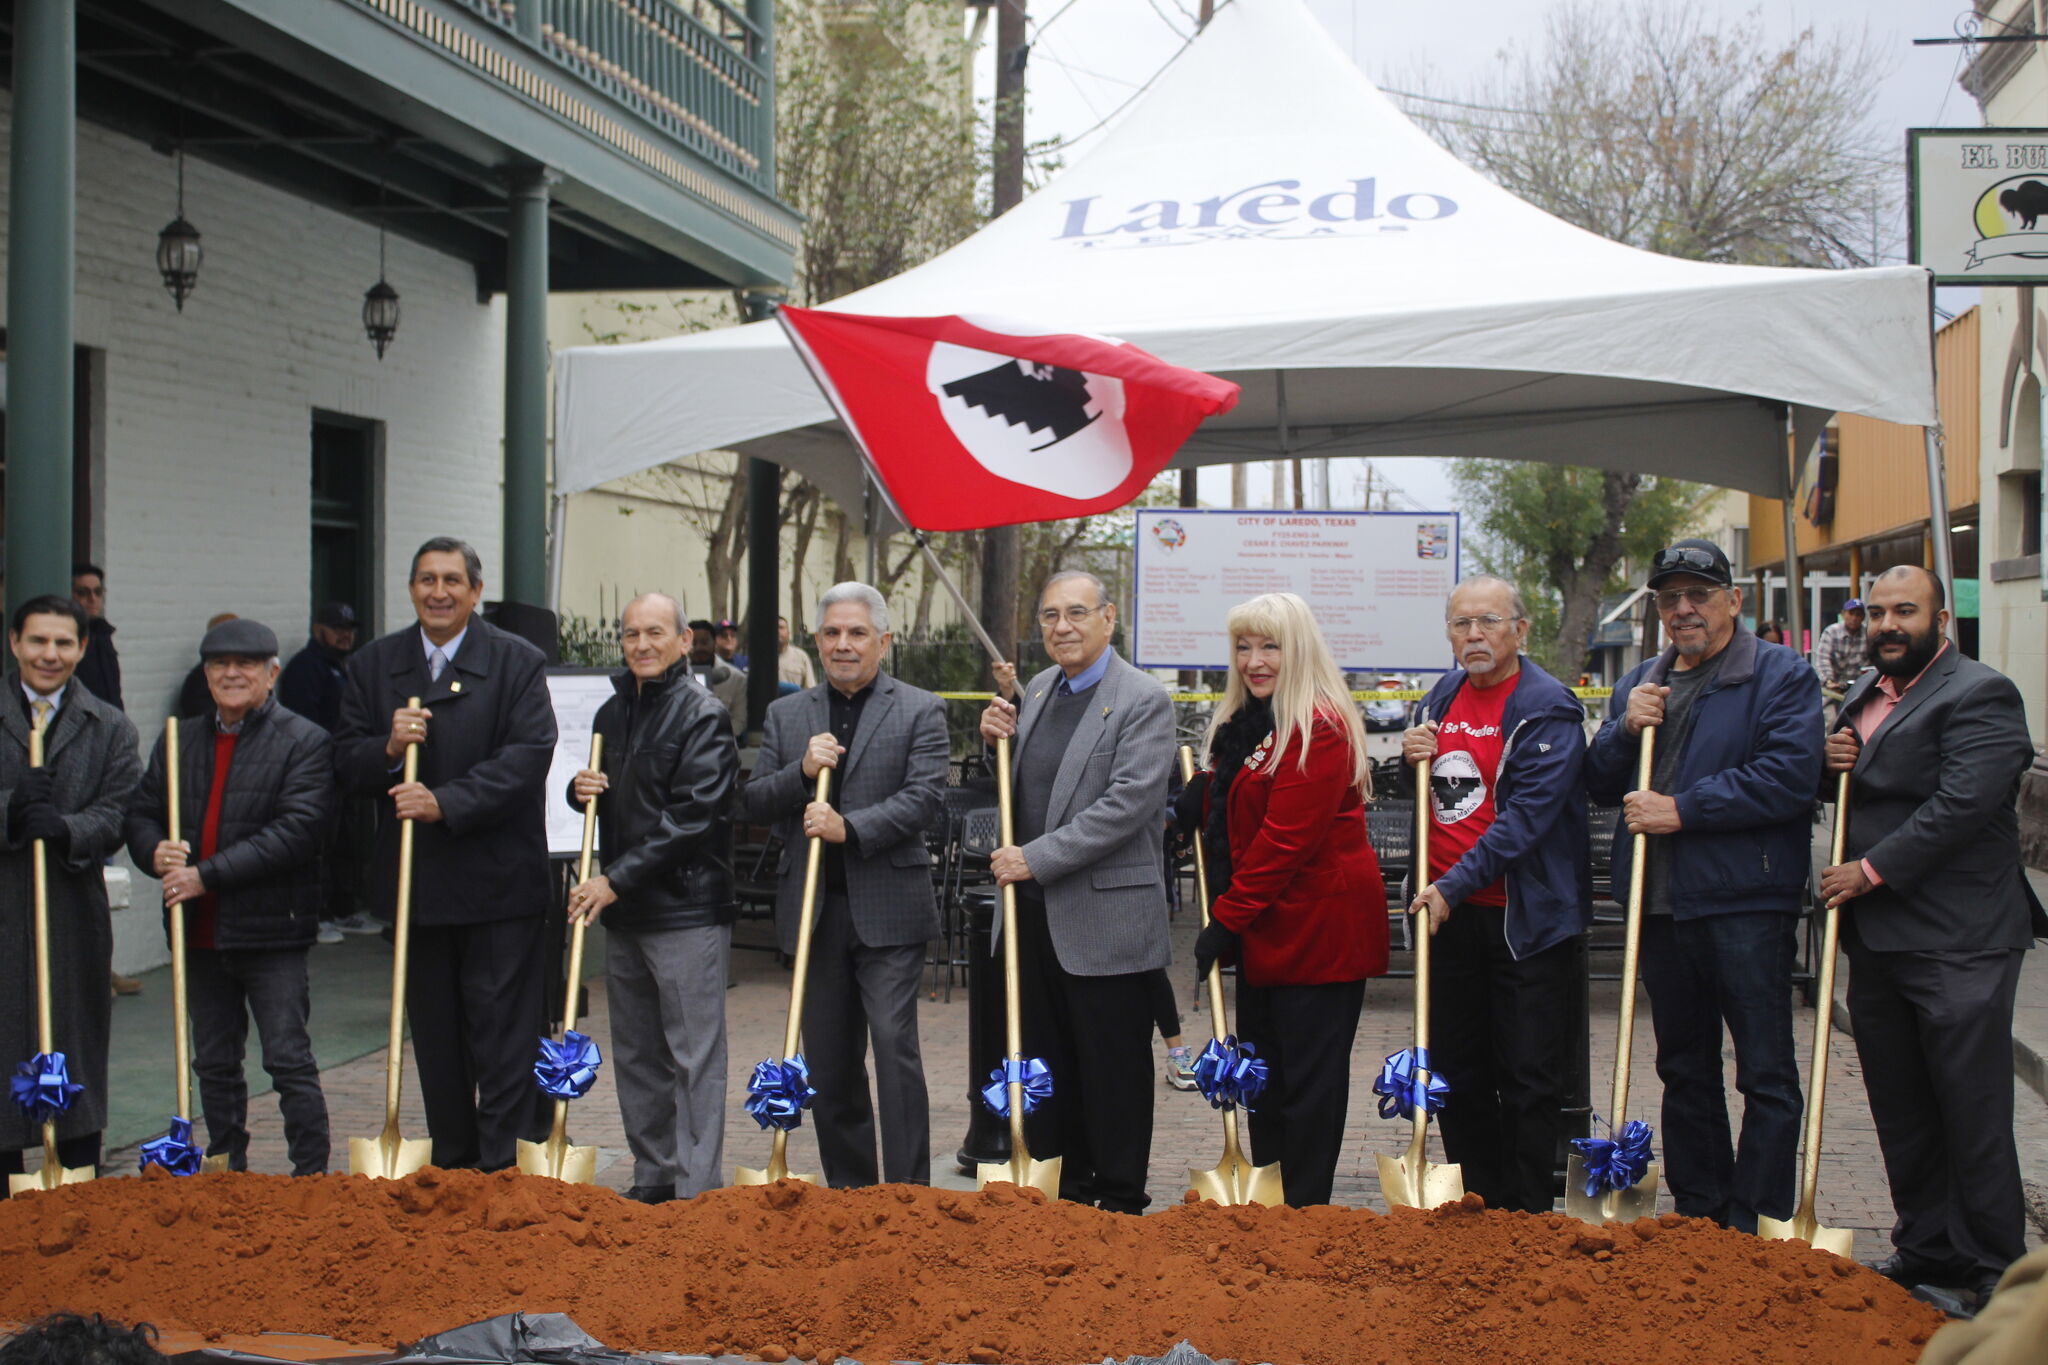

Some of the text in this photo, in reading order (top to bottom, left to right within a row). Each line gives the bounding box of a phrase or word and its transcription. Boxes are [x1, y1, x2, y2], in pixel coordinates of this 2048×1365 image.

[1961, 144, 1999, 169] EL
[1050, 176, 1459, 241] Laredo
[1238, 518, 1260, 526] CITY
[1264, 518, 1276, 526] OF
[1325, 518, 1357, 528] TEXAS
[1444, 722, 1459, 734] Se
[1460, 721, 1500, 738] Puede!
[1457, 801, 1478, 818] March
